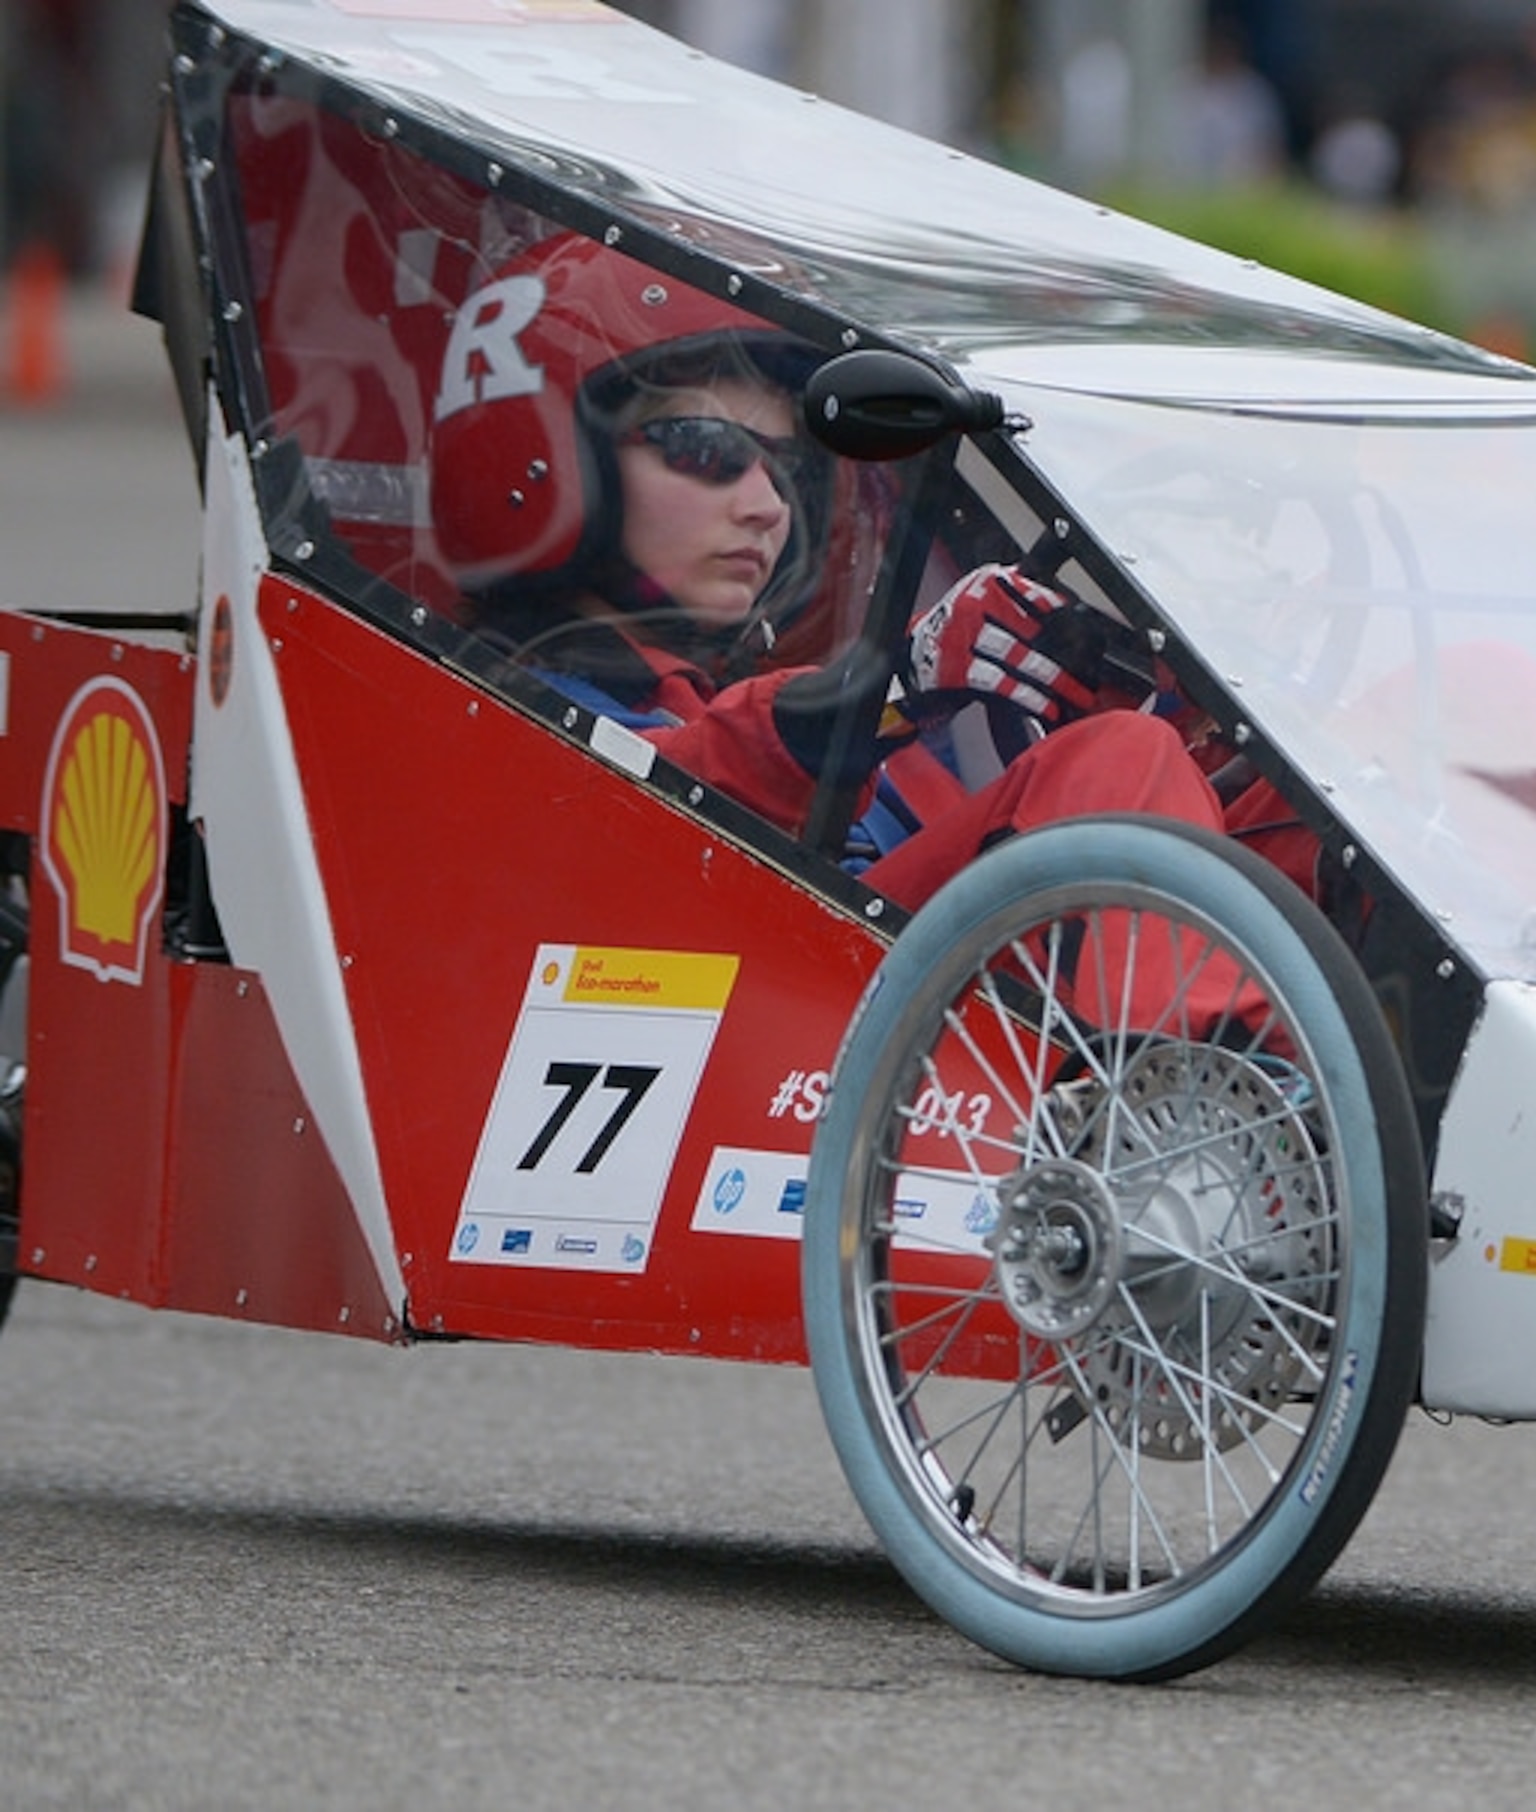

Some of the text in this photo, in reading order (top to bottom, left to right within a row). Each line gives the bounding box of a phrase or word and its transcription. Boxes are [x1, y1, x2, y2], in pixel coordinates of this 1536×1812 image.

[434, 274, 547, 423] R
[575, 973, 661, 993] Eco-marathon
[516, 1061, 664, 1174] 77
